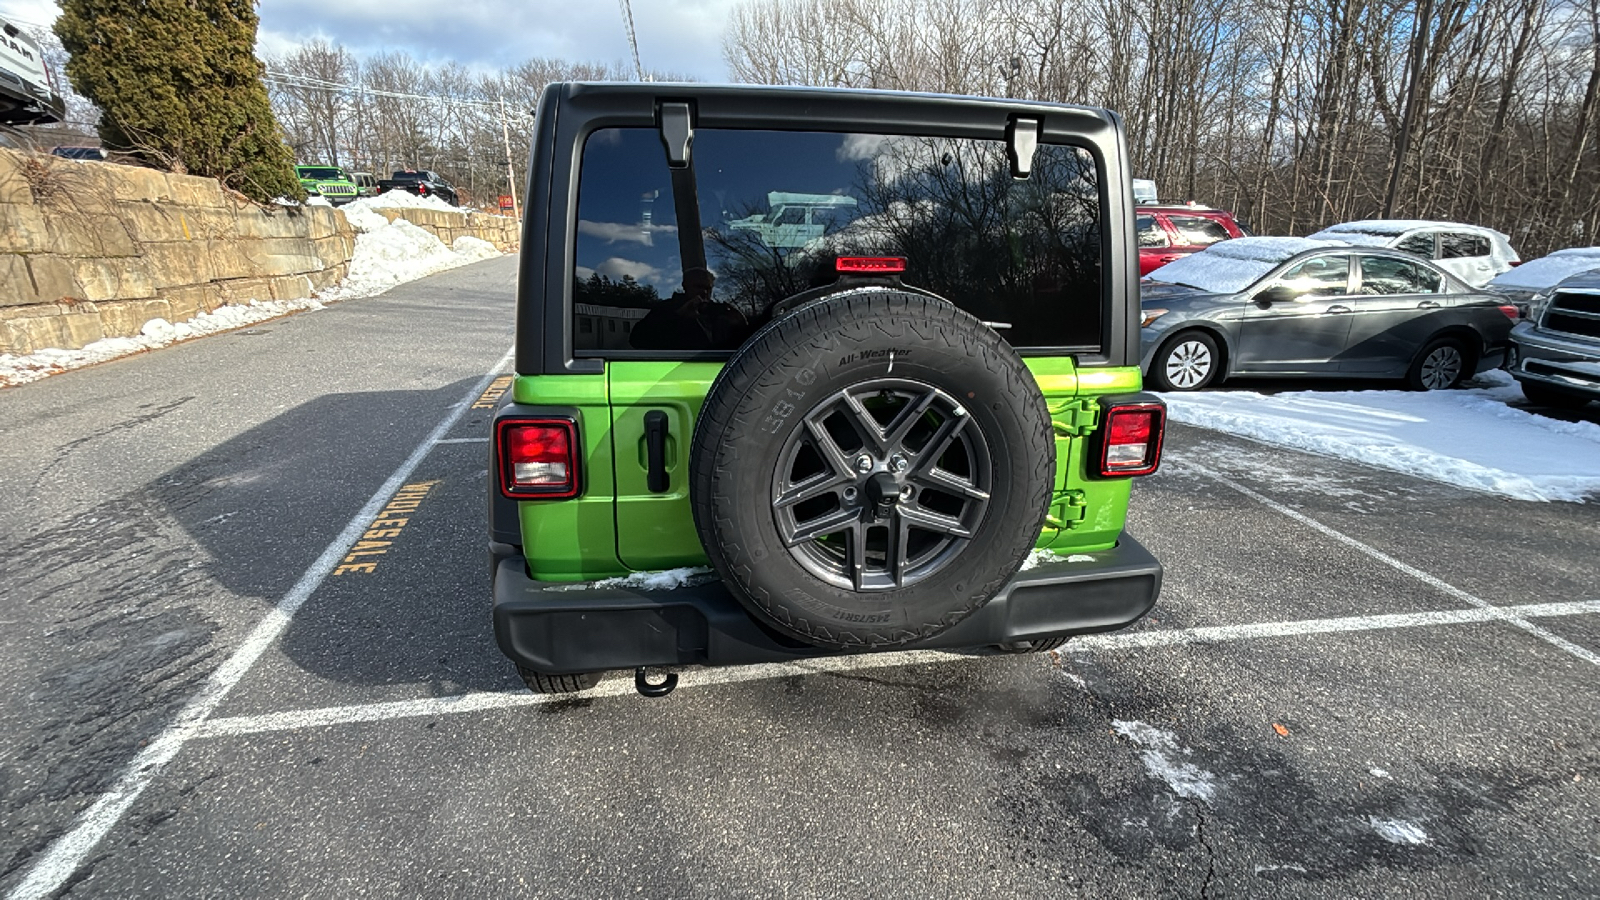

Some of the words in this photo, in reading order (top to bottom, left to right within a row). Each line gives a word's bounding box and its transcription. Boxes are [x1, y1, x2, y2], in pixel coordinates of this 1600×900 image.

[838, 347, 913, 367] All-Weather
[333, 479, 443, 576] WHOLESALE
[833, 610, 891, 623] 245/75R17
